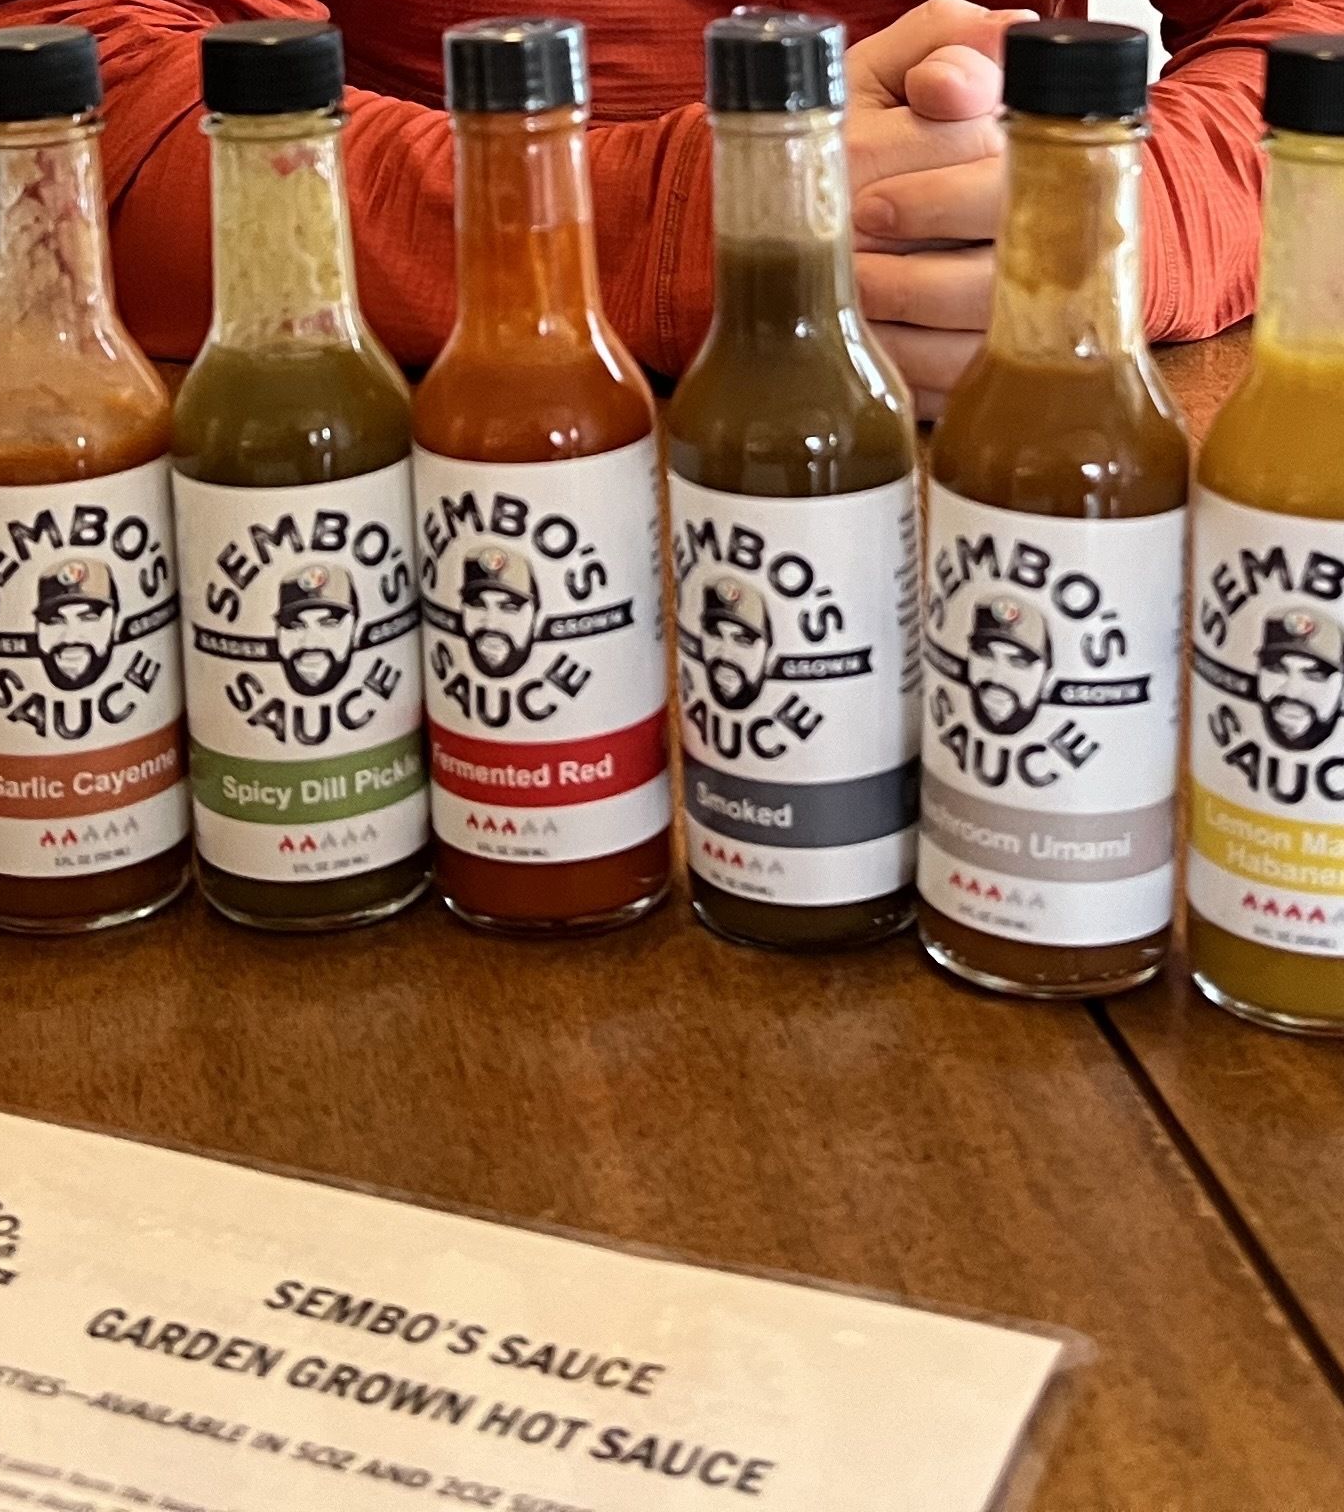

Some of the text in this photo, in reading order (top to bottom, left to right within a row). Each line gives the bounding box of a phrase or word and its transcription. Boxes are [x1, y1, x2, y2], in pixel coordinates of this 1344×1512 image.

[205, 509, 410, 624] SEMBO'S
[224, 656, 402, 747] SAUCE
[430, 639, 593, 729] SAUCE
[930, 685, 1101, 789] SAUCE
[72, 746, 178, 797] Cayenne
[222, 774, 294, 811] Spicy
[300, 775, 348, 804] Dill
[558, 753, 615, 786] Red
[695, 780, 795, 830] Smoked
[1204, 796, 1293, 852] Lemon
[1028, 831, 1132, 863] Umami
[264, 1278, 667, 1397] SEMBO'S SAUCE
[84, 1306, 778, 1495] GARDEN GROWN HOT SAUCE
[356, 1458, 434, 1489] AND
